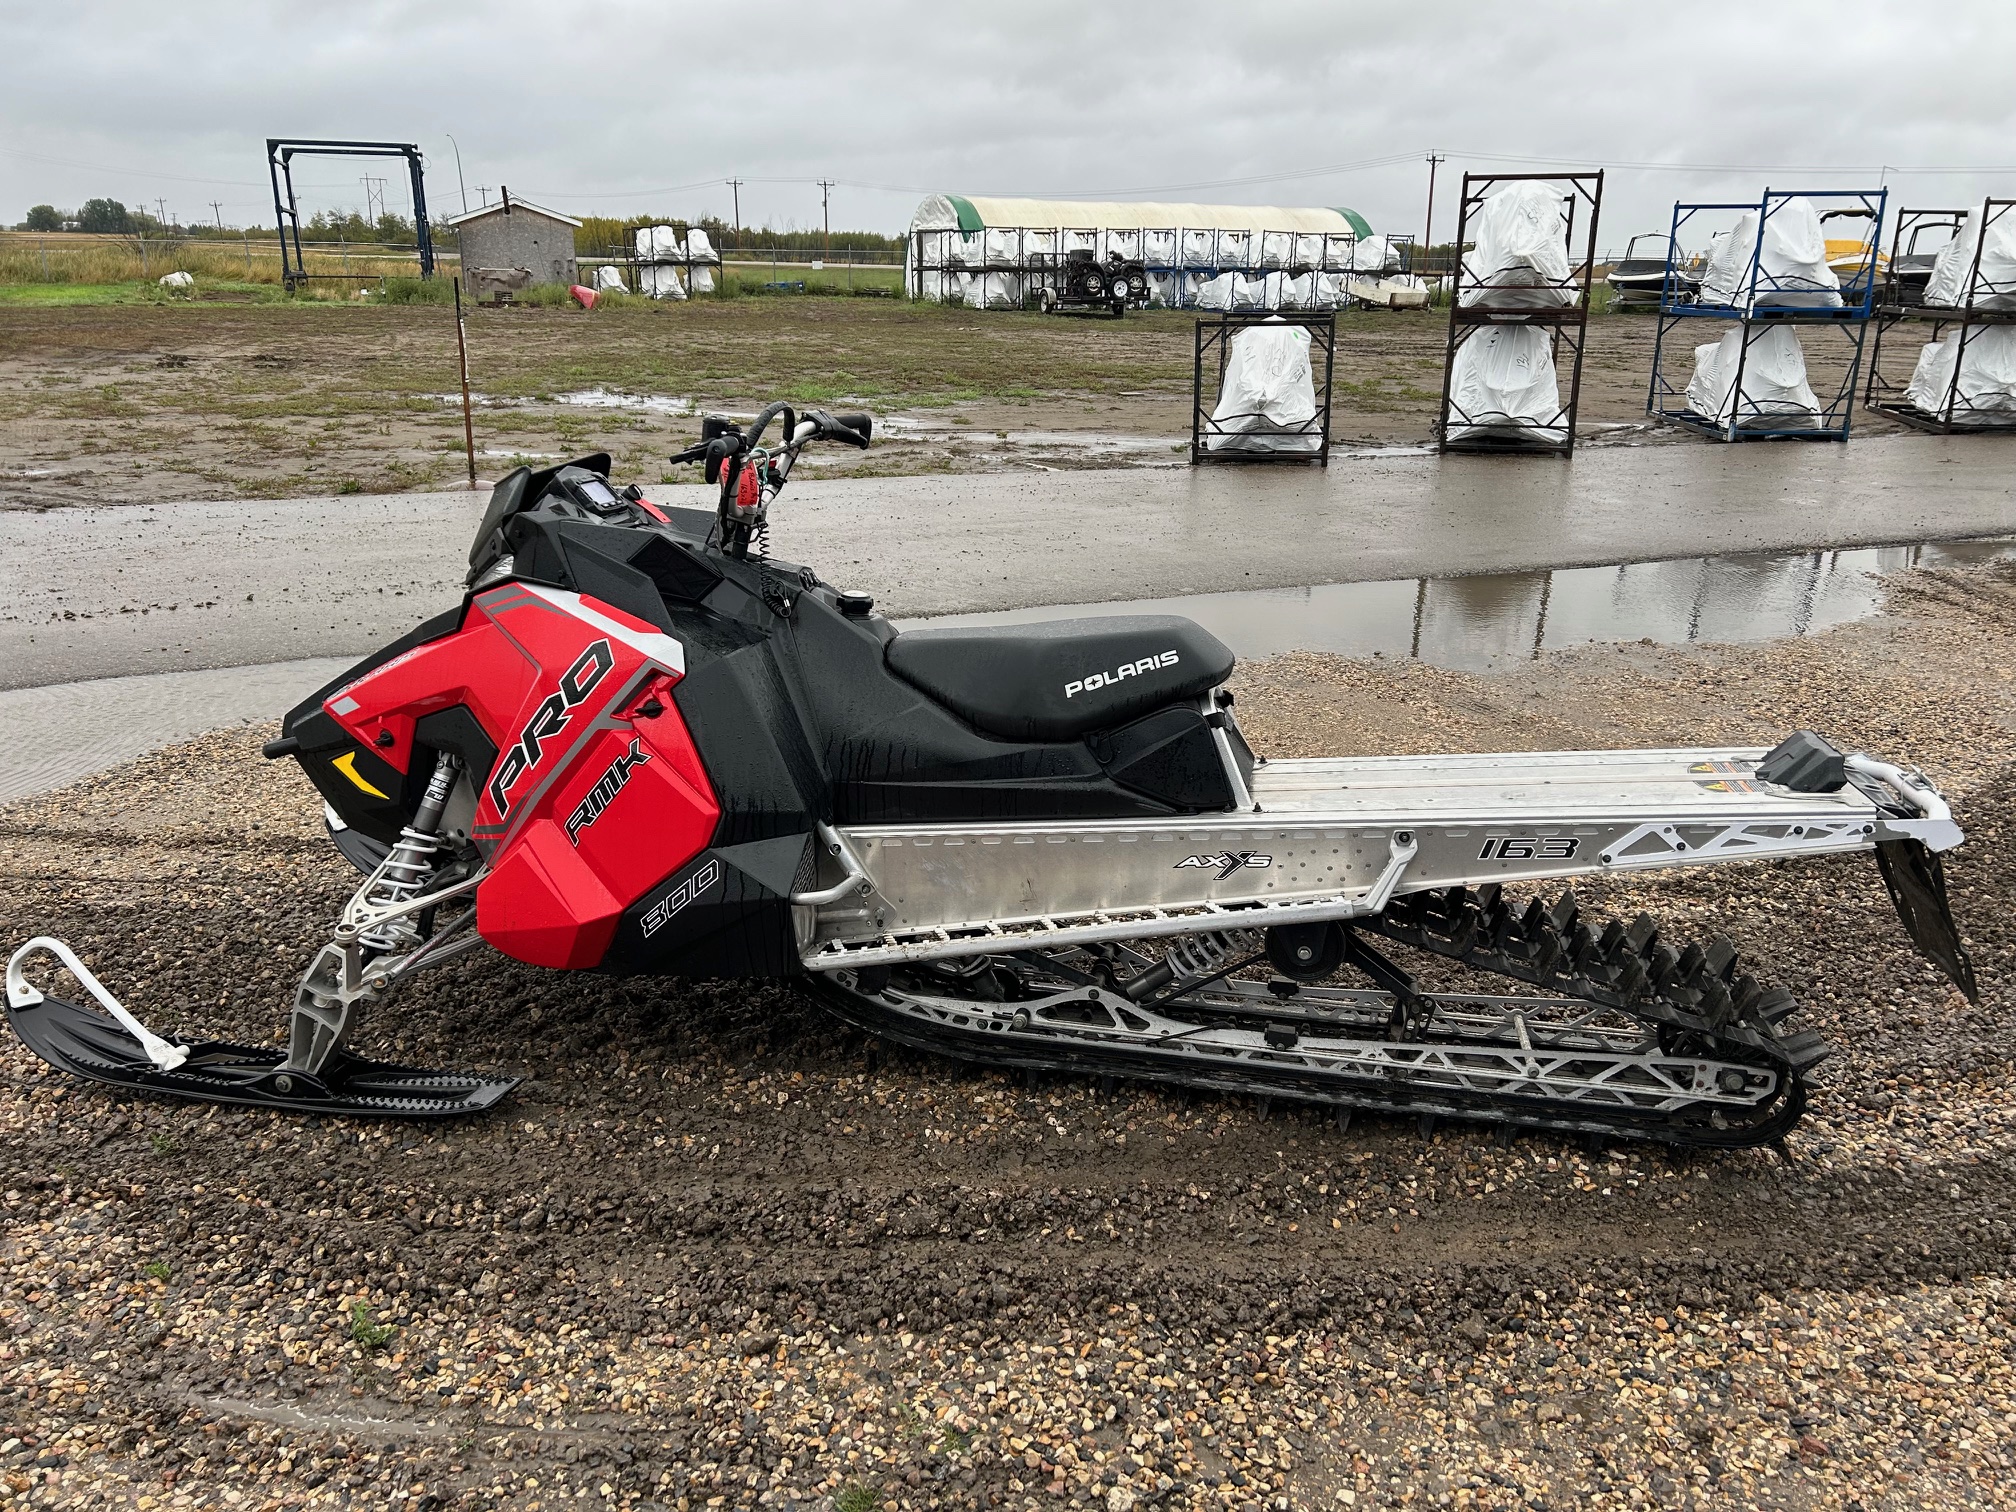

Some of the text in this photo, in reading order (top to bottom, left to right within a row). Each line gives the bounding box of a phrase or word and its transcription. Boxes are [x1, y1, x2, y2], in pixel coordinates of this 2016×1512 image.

[1064, 649, 1179, 698] POLARIS
[489, 638, 615, 821] PRO
[564, 736, 653, 848] RMK
[1173, 851, 1273, 880] AXYS
[1477, 837, 1581, 860] 163
[640, 858, 719, 938] 800
